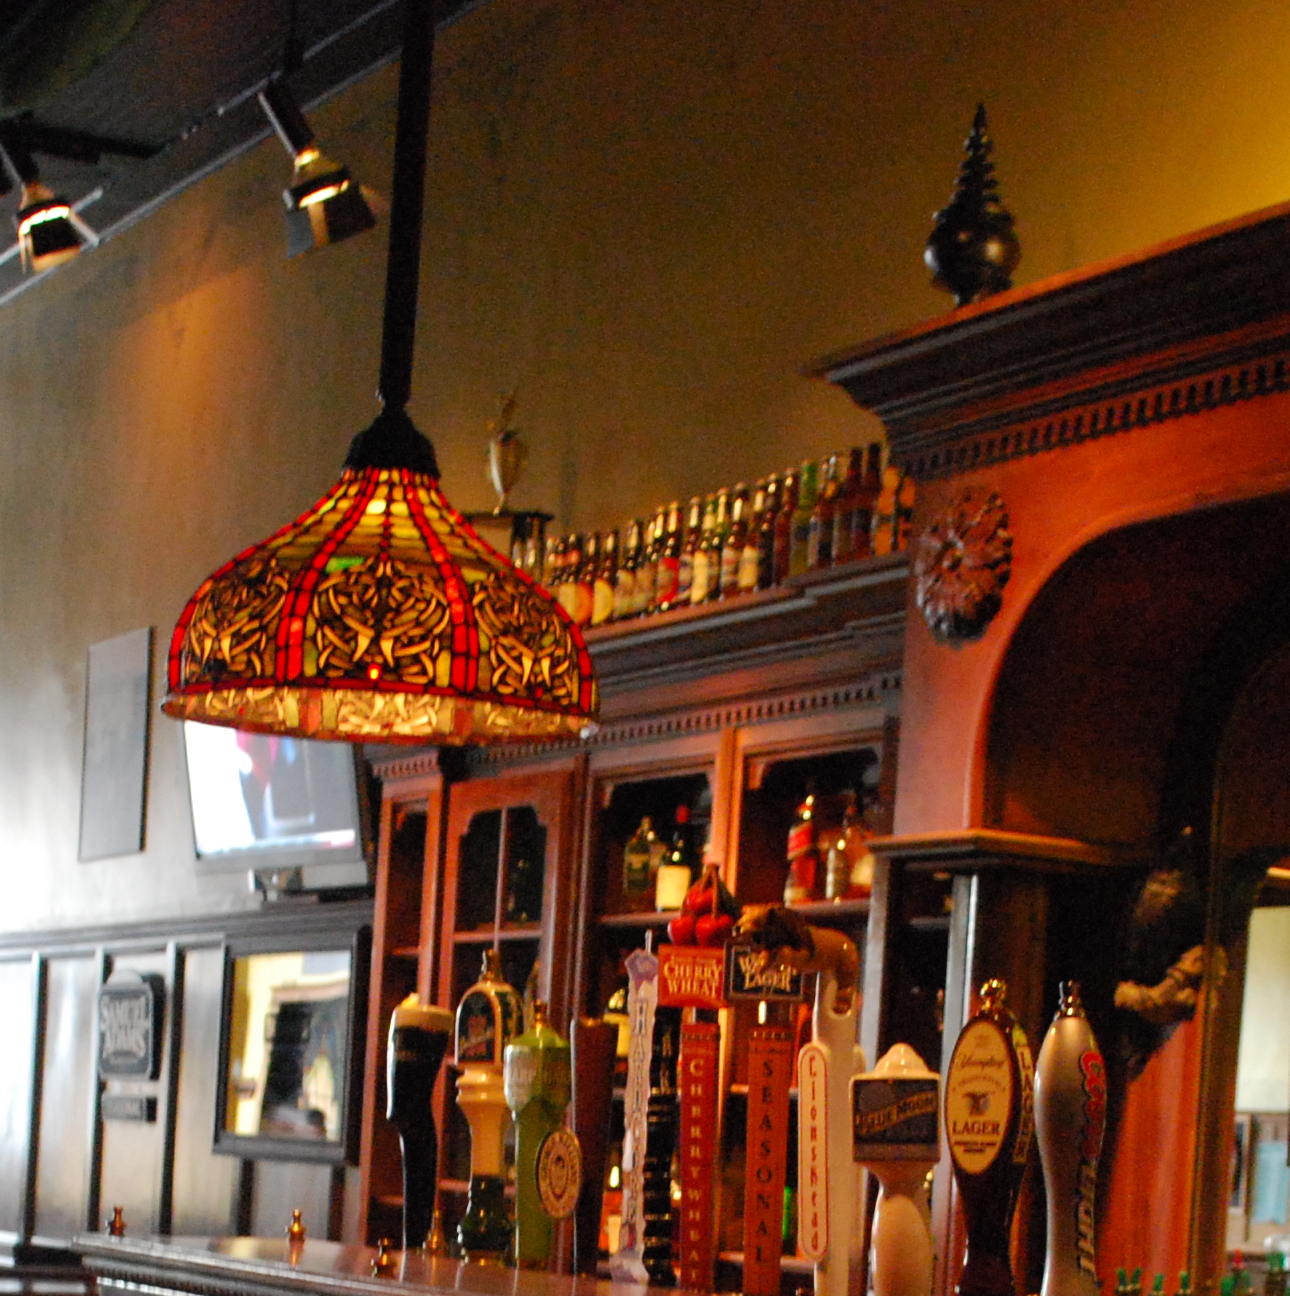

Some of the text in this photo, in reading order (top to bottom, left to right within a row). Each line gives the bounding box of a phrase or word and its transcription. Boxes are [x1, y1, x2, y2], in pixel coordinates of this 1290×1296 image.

[664, 961, 723, 980] CHERRY
[668, 978, 717, 998] WHEAT
[952, 1119, 1001, 1136] LAGER
[755, 1060, 774, 1262] SEASONAL
